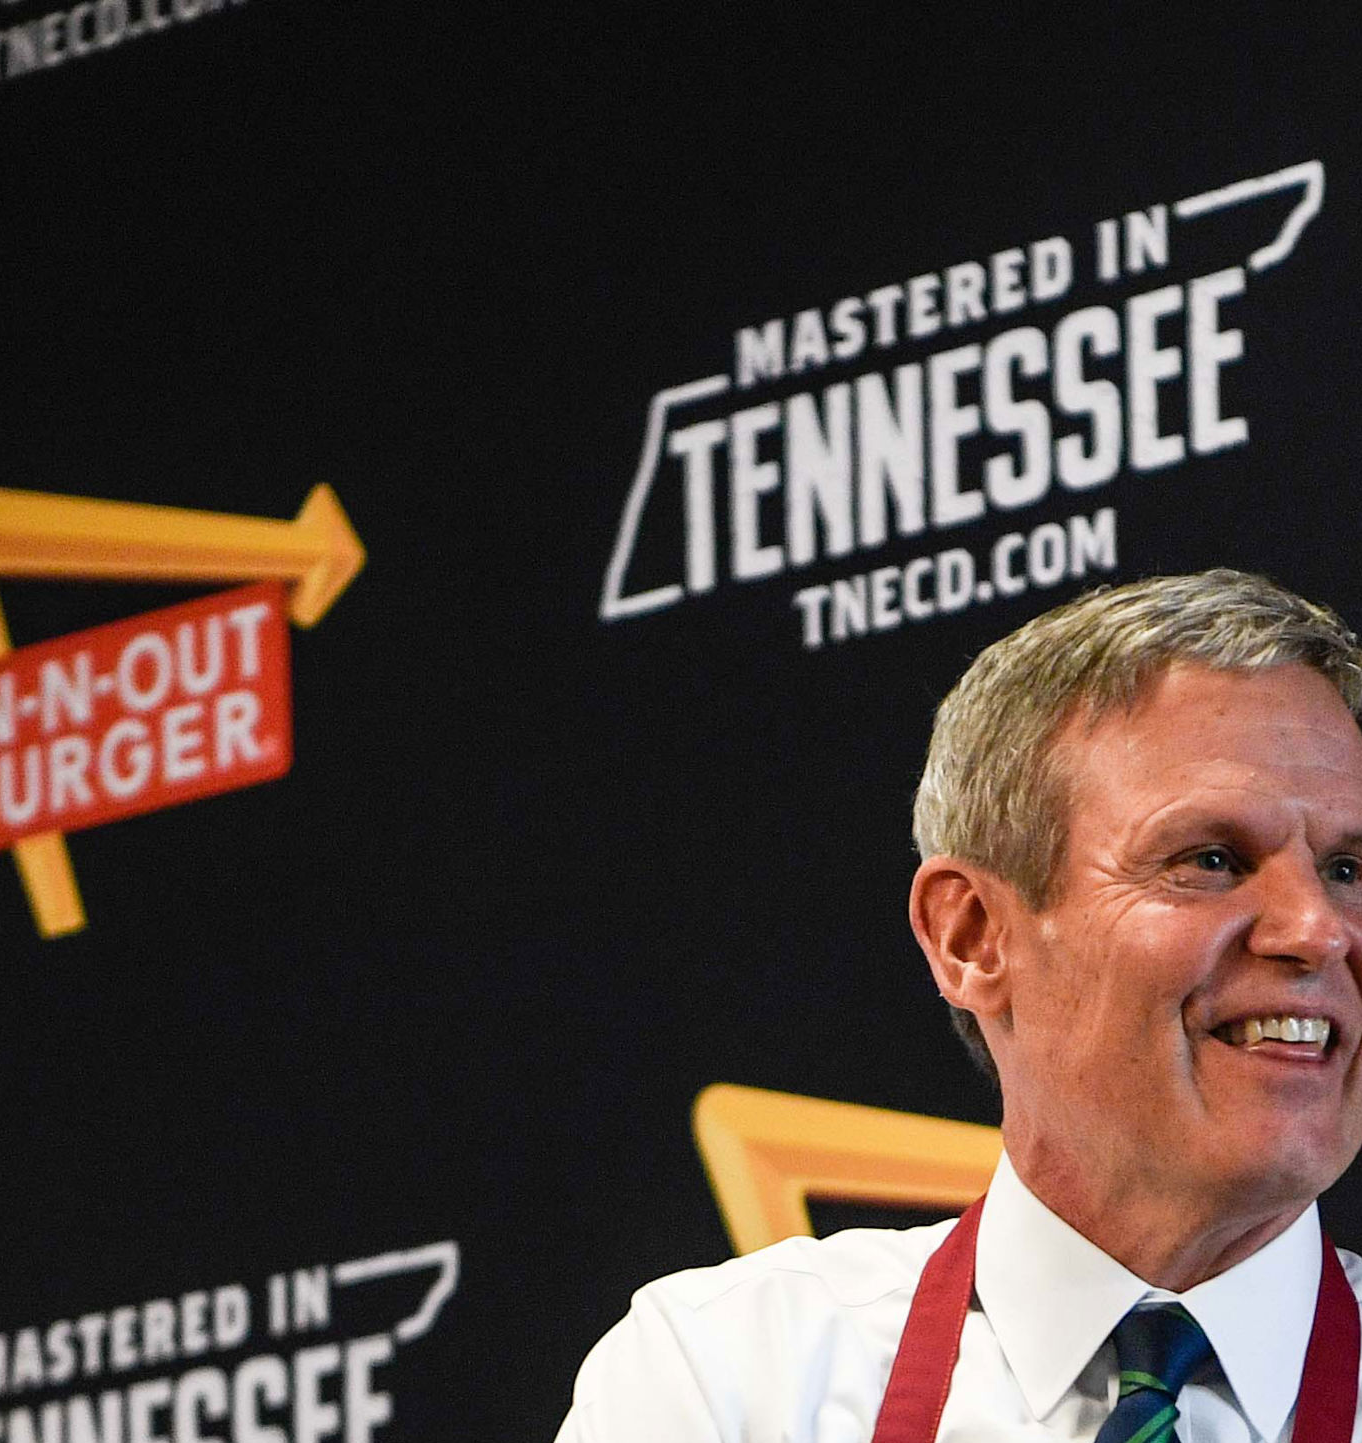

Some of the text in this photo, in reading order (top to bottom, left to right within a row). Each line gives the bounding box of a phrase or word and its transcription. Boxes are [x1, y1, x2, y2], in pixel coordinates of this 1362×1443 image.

[738, 203, 1169, 389] MASTERED IN
[669, 267, 1249, 594] TENNESSEE
[795, 508, 1117, 649] TNECD.COM
[268, 1265, 331, 1336] IN
